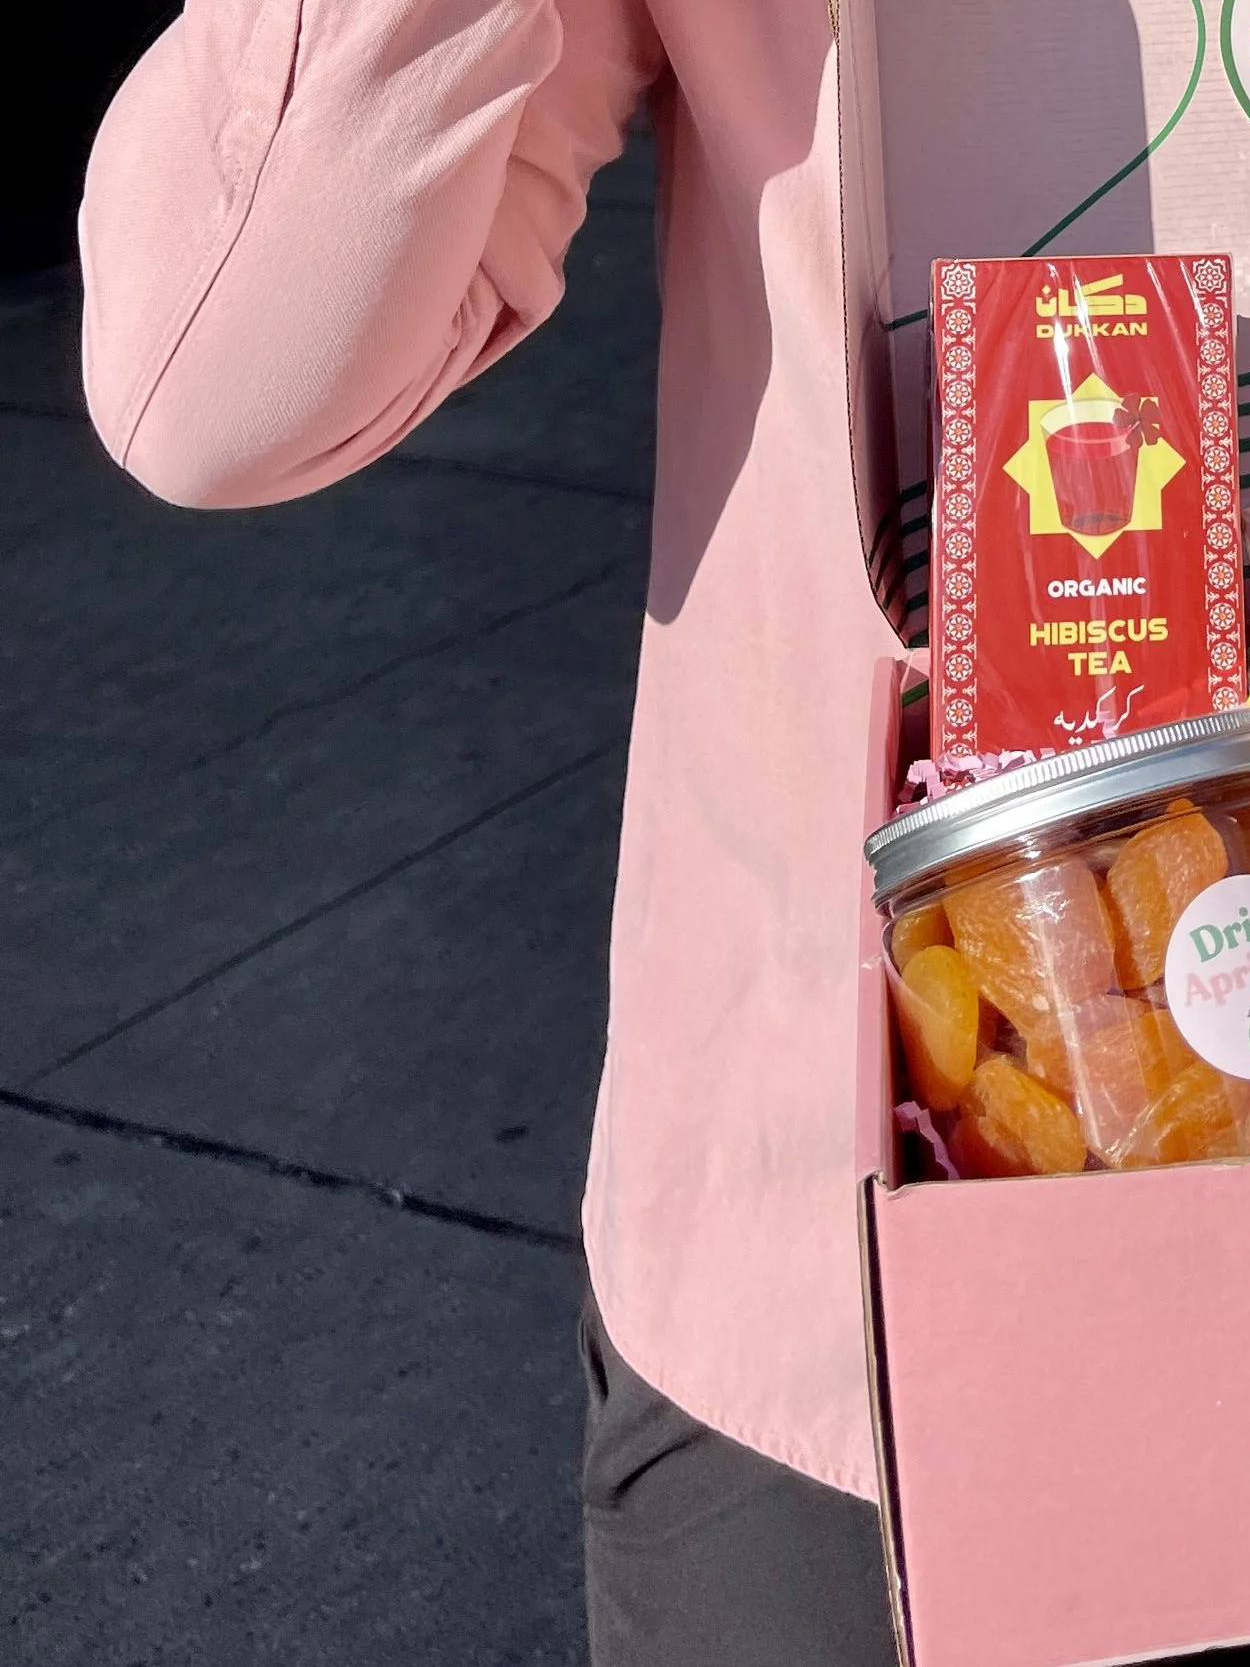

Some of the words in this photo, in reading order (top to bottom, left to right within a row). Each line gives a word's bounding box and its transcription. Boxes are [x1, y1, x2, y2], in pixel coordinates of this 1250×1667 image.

[1036, 322, 1147, 338] DUKKAN
[1048, 577, 1147, 598] ORGANIC
[1029, 618, 1168, 646] HIBISCUS
[1068, 651, 1132, 676] TEA
